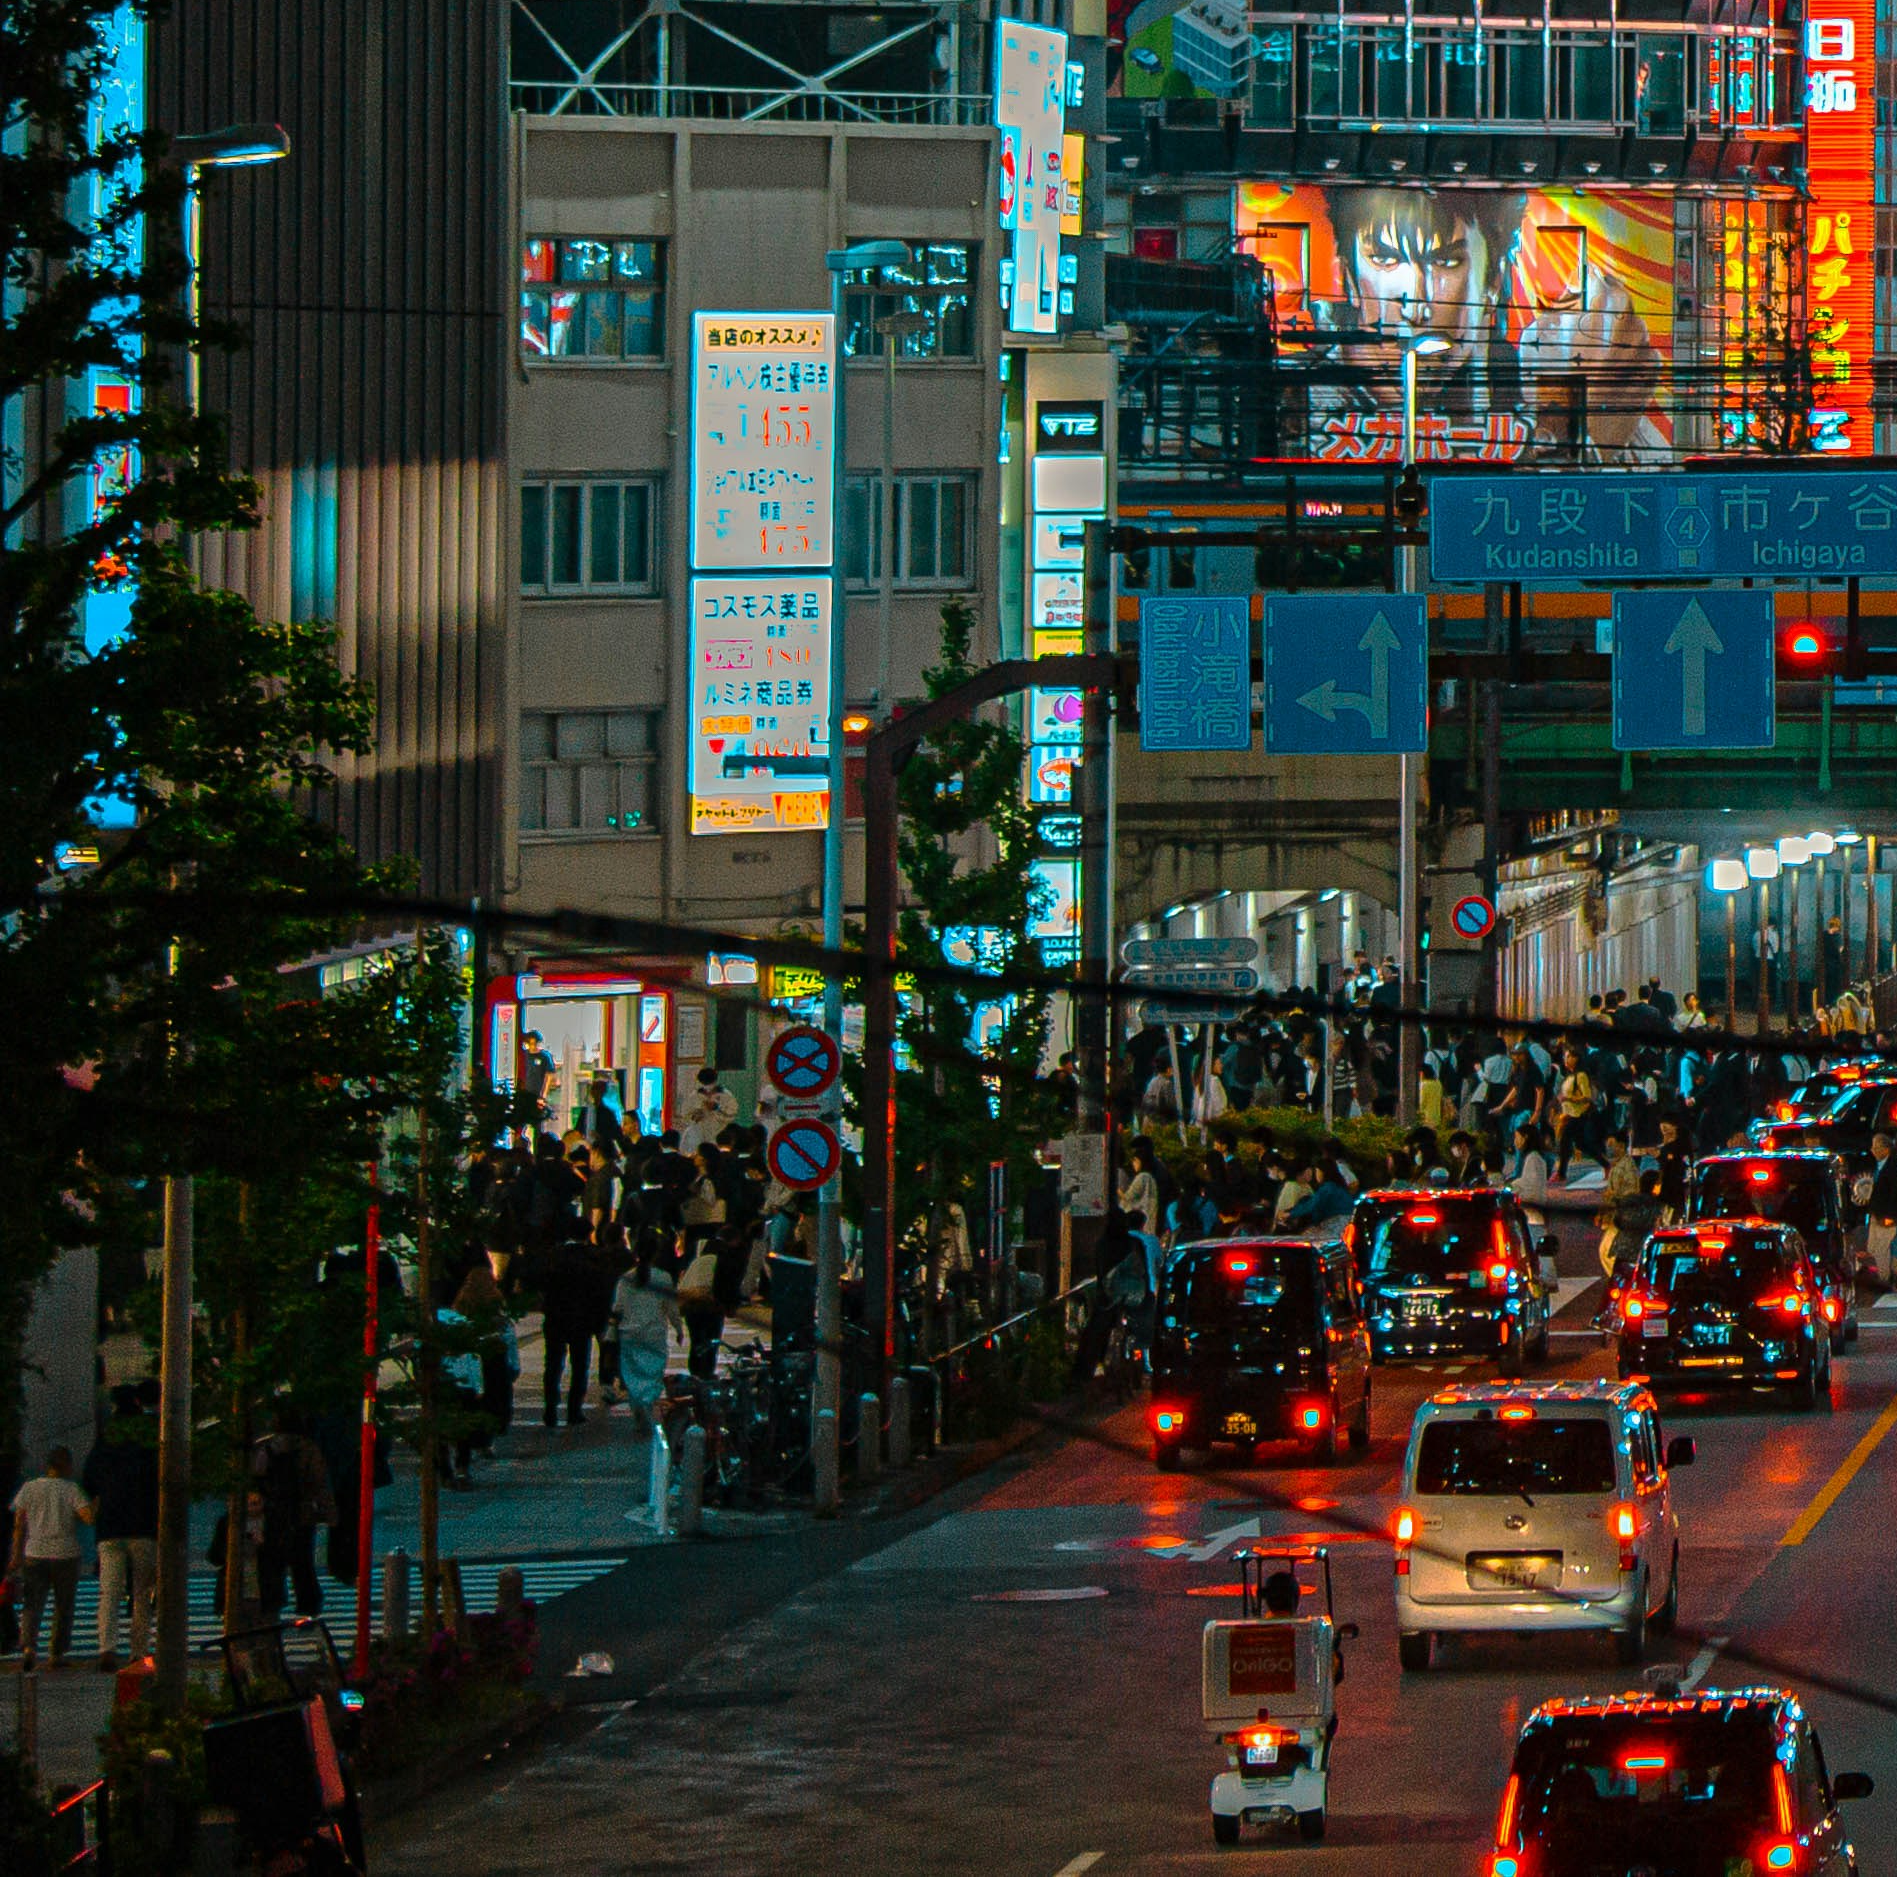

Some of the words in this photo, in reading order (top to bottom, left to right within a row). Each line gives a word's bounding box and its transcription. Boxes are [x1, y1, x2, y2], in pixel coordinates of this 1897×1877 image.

[708, 328, 807, 347] 当店のオススメ
[1320, 413, 1529, 464] メガホール
[1473, 486, 1654, 537] 九段下
[1677, 514, 1698, 540] 4
[1485, 542, 1639, 571] Kudanshita
[1752, 539, 1867, 569] Ichigaya
[705, 593, 819, 620] コスモス薬品
[705, 680, 813, 707] ルミネ商品券
